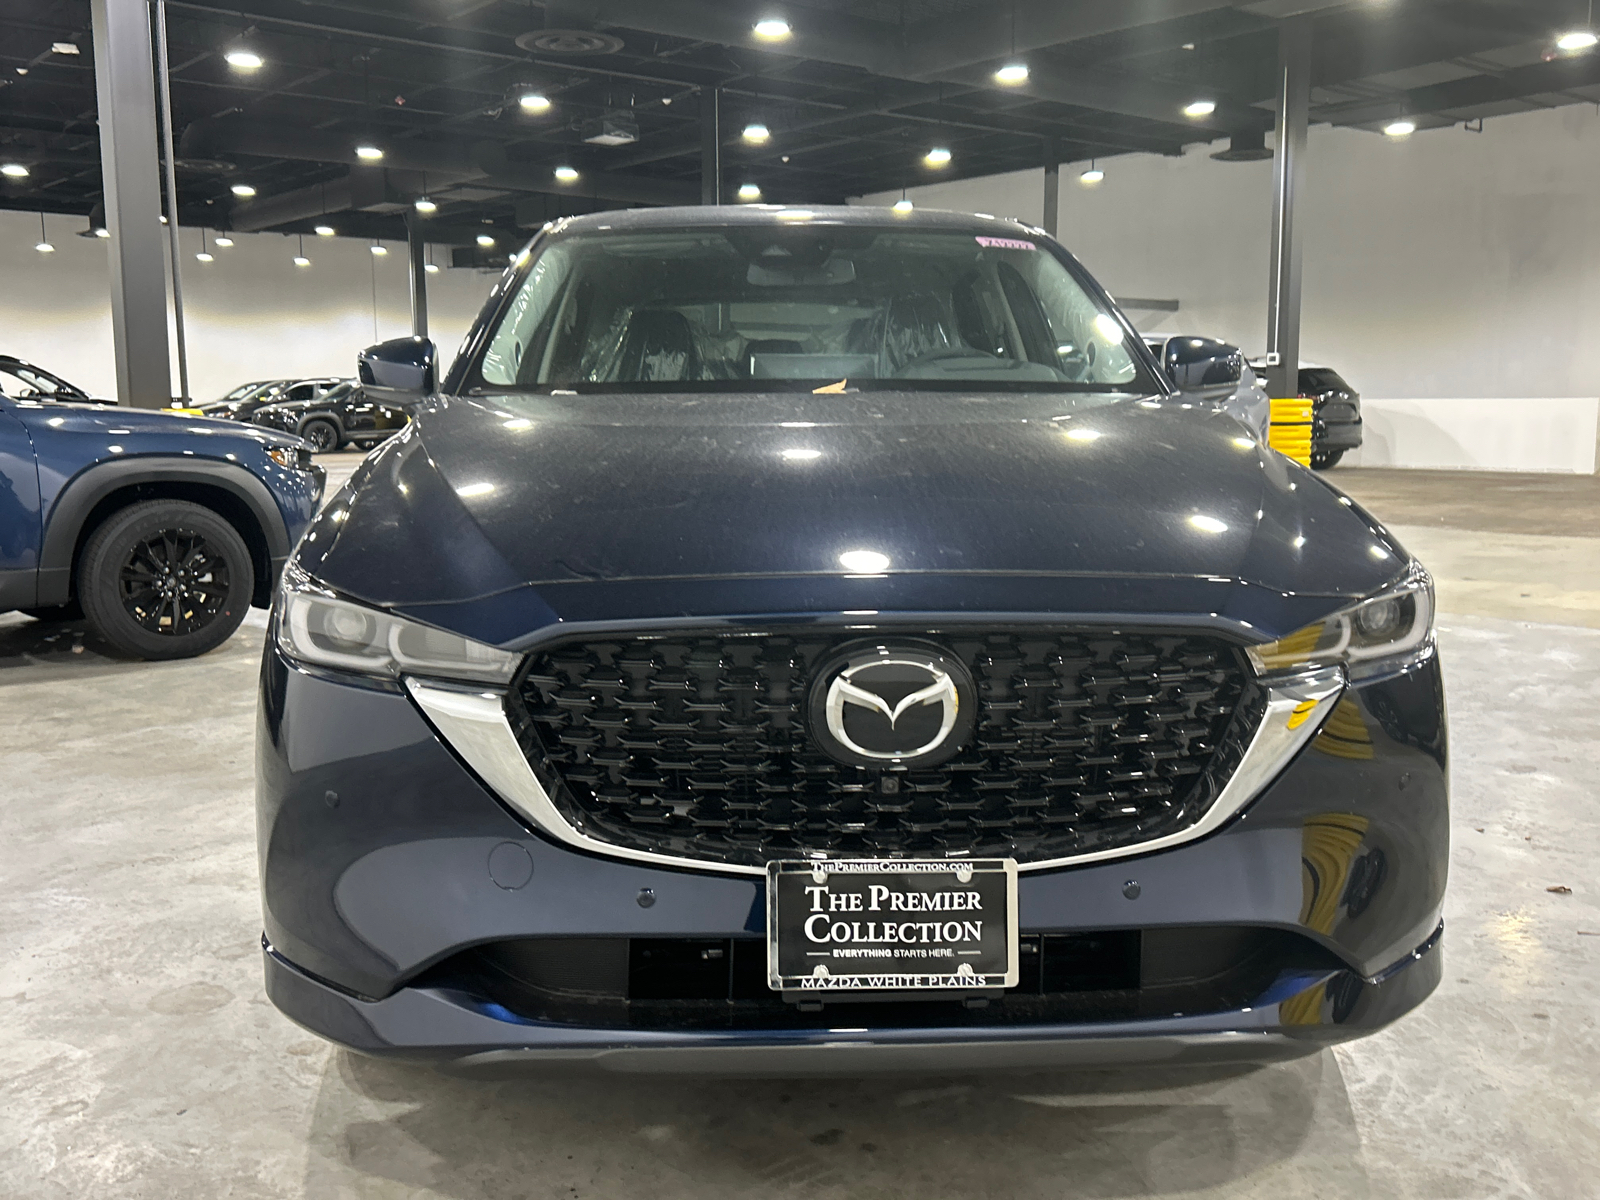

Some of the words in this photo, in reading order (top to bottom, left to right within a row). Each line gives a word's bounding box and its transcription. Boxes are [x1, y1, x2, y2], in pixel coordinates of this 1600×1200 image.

[804, 886, 863, 912] THE
[868, 885, 982, 911] PREMIER
[804, 914, 983, 943] COLLECTION
[833, 949, 892, 958] EVERYTHING
[894, 949, 927, 958] STARTS
[801, 977, 862, 988] MAZDA
[868, 977, 922, 987] WHITE
[929, 976, 986, 987] PLAINS
